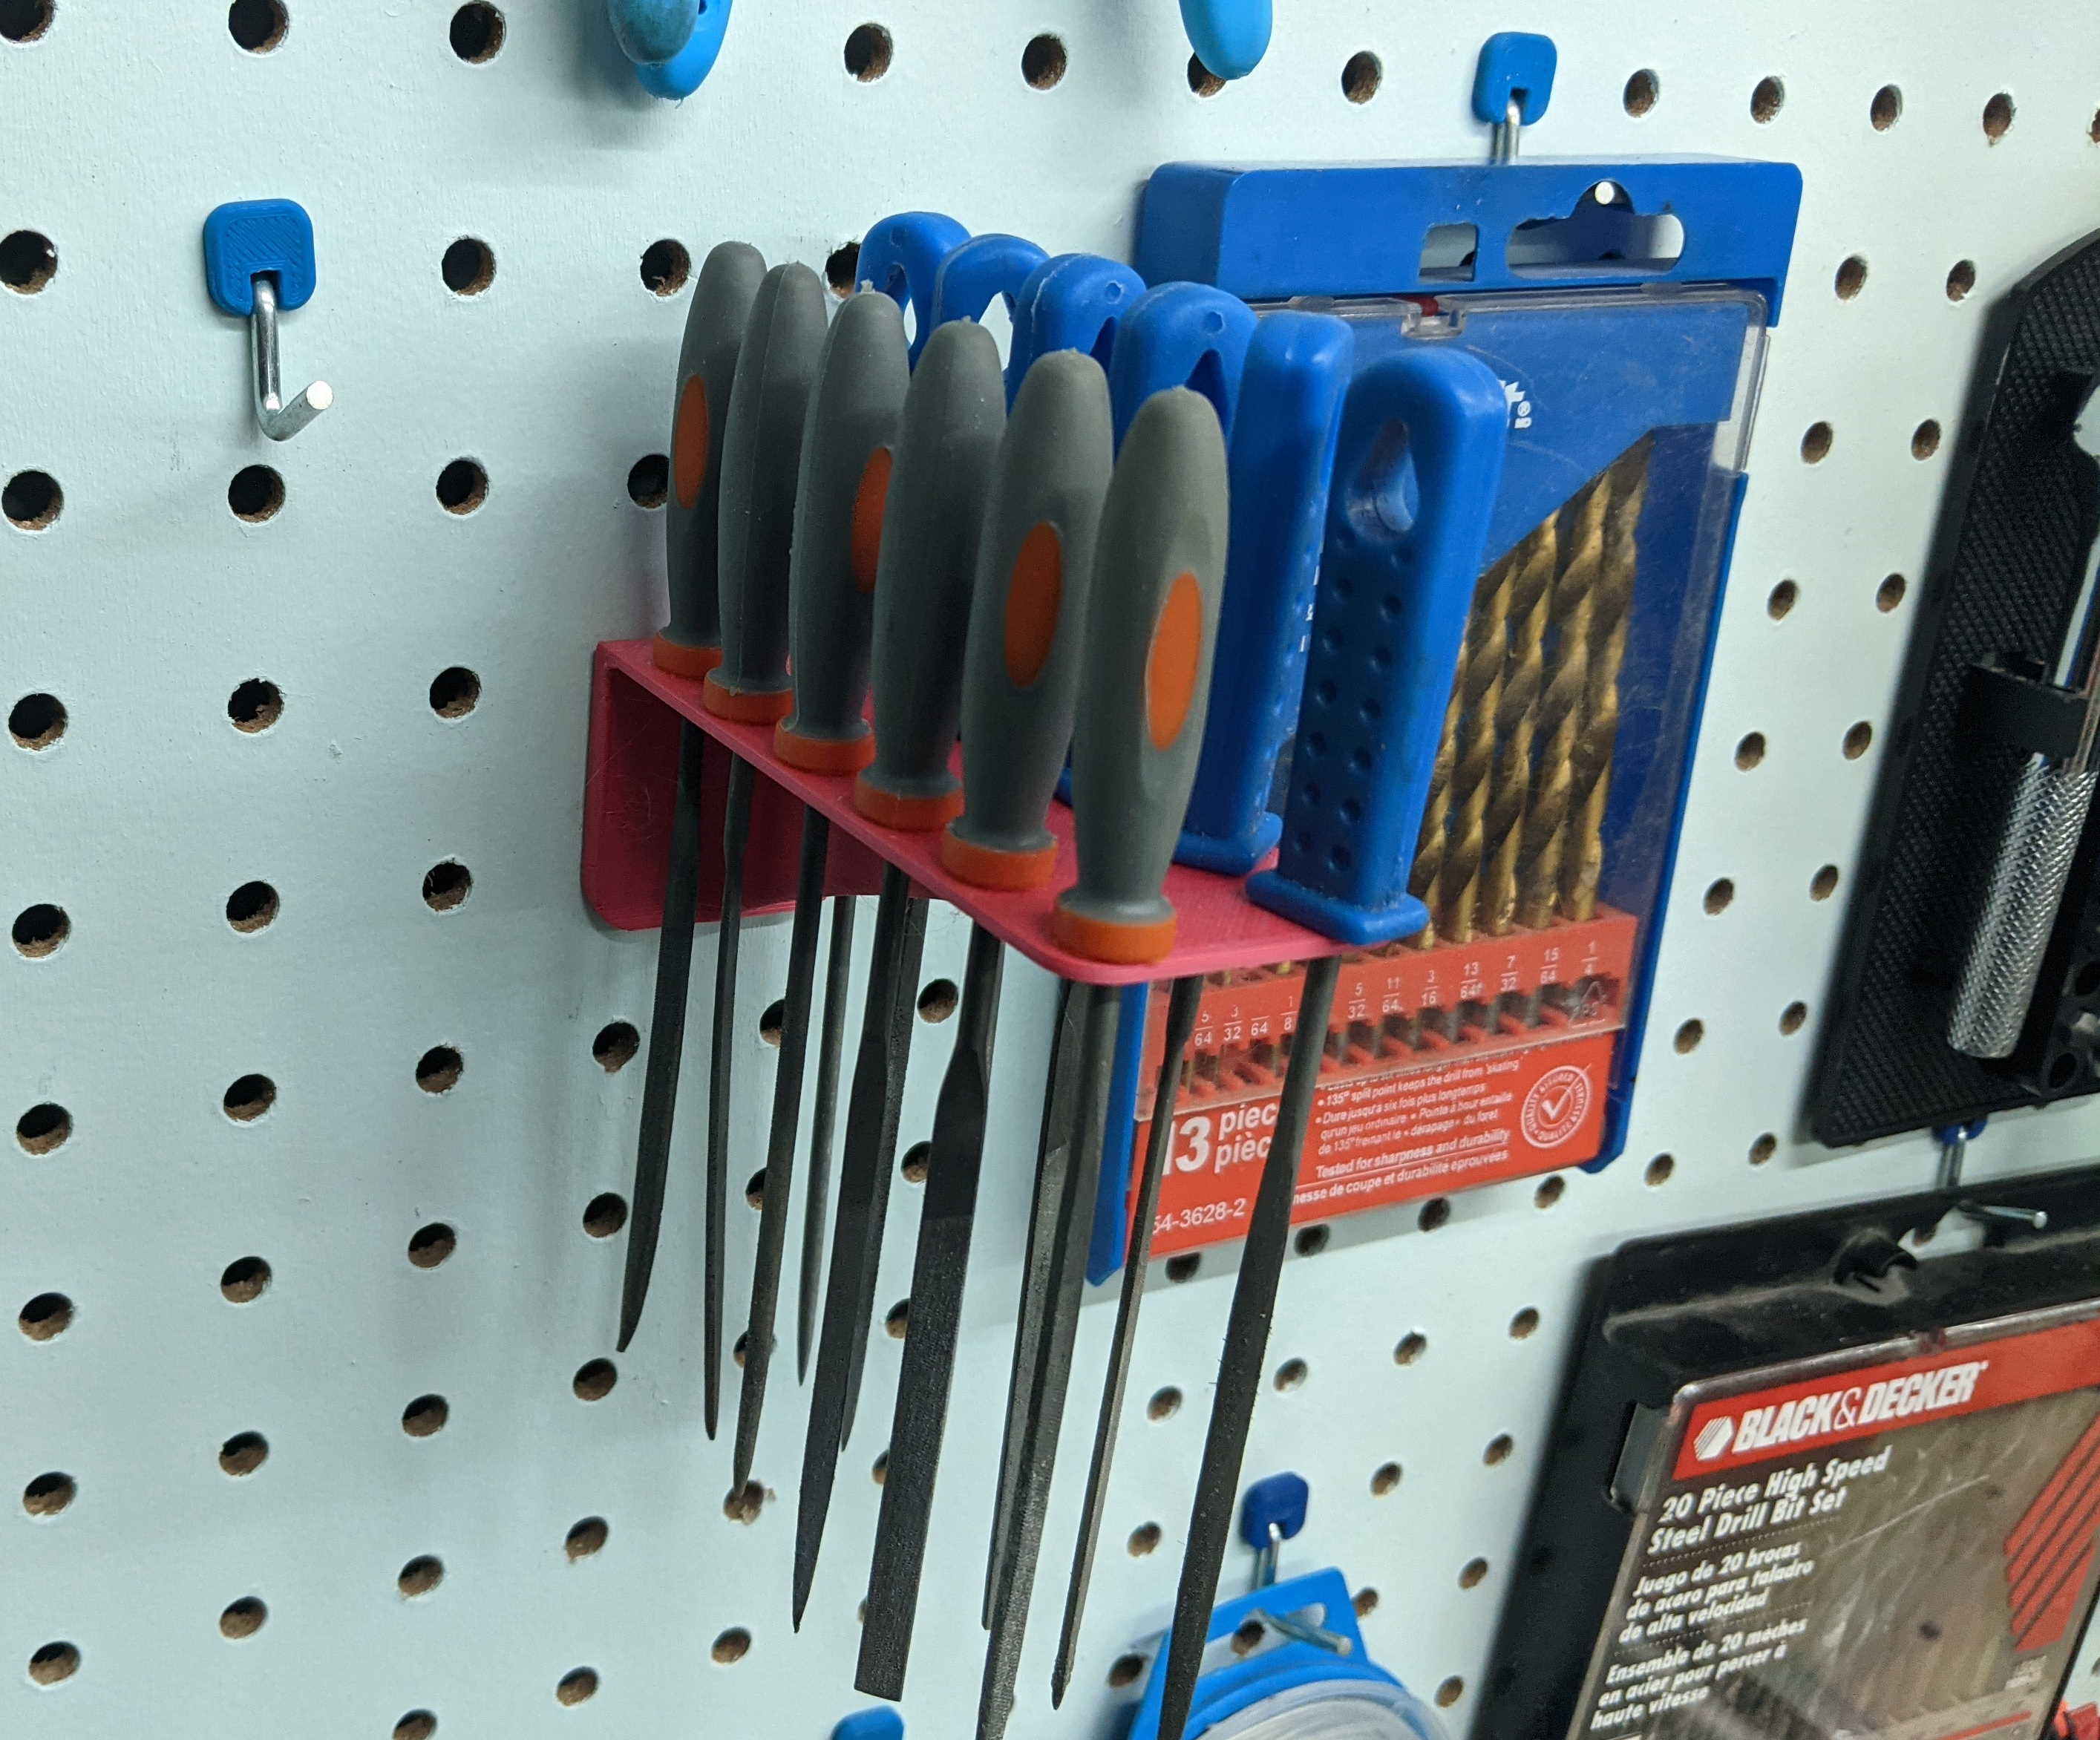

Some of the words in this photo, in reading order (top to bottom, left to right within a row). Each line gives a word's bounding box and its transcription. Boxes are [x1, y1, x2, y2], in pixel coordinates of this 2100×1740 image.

[1506, 955, 1516, 969] 7
[1543, 946, 1560, 963] 15
[1426, 969, 1435, 984] 3
[1463, 961, 1479, 976] 13
[1354, 982, 1363, 996] 5
[1387, 976, 1401, 990] 11
[1499, 976, 1517, 992] 32
[1347, 1004, 1367, 1019] 32
[1421, 991, 1438, 1007] 16
[1224, 1027, 1242, 1041] 32
[1250, 1021, 1269, 1037] 64
[1283, 1016, 1292, 1031] 8
[1194, 1031, 1213, 1047] 64
[1350, 1086, 1372, 1104] split
[1372, 1081, 1397, 1099] point
[1398, 1078, 1427, 1093] keeps
[1427, 1074, 1443, 1087] the
[1443, 1069, 1462, 1084] drill
[1462, 1067, 1484, 1080] from
[1322, 1110, 1347, 1125] Dure
[1383, 1100, 1398, 1112] six
[1416, 1093, 1437, 1107] plus
[1437, 1082, 1488, 1102] longtemps
[1218, 1103, 1278, 1141] piec
[1214, 1131, 1272, 1174] pièc
[1316, 1158, 1355, 1178] Tested
[1355, 1156, 1374, 1171] for
[1374, 1145, 1434, 1168] sharpness
[1435, 1137, 1459, 1153] and
[1459, 1128, 1511, 1148] durability
[1317, 1143, 1332, 1156] de
[1293, 1188, 1329, 1206] nesse
[1329, 1183, 1345, 1197] de
[1345, 1176, 1383, 1194] coupe
[1383, 1172, 1396, 1185] et
[1658, 1492, 1696, 1523] 20
[1697, 1482, 1762, 1515] Piece
[1764, 1462, 1819, 1500] High
[1821, 1445, 1892, 1488] Speed
[1647, 1515, 1713, 1556] Steel
[1713, 1502, 1769, 1538] Drill
[1770, 1495, 1807, 1524] Bit
[1808, 1486, 1848, 1515] Set
[1633, 1570, 1690, 1597] Juego
[1691, 1560, 1715, 1583] de
[1718, 1551, 1745, 1574] 20
[1745, 1541, 1802, 1569] brocas
[1626, 1597, 1652, 1621] de
[1653, 1588, 1704, 1614] acero
[1704, 1576, 1749, 1605] para
[1750, 1560, 1816, 1588] taladro
[1618, 1621, 1645, 1645] de
[1646, 1612, 1686, 1637] alta
[1687, 1587, 1770, 1627] velocidad
[1606, 1644, 1691, 1687] Ensemble
[1692, 1639, 1716, 1663] de
[1718, 1632, 1744, 1655] 20
[1597, 1688, 1623, 1708] en
[1625, 1675, 1670, 1702] acier
[1671, 1664, 1715, 1692] pour
[1715, 1647, 1773, 1682] percer
[1590, 1703, 1646, 1731] haute
[1648, 1685, 1710, 1715] vitesse
